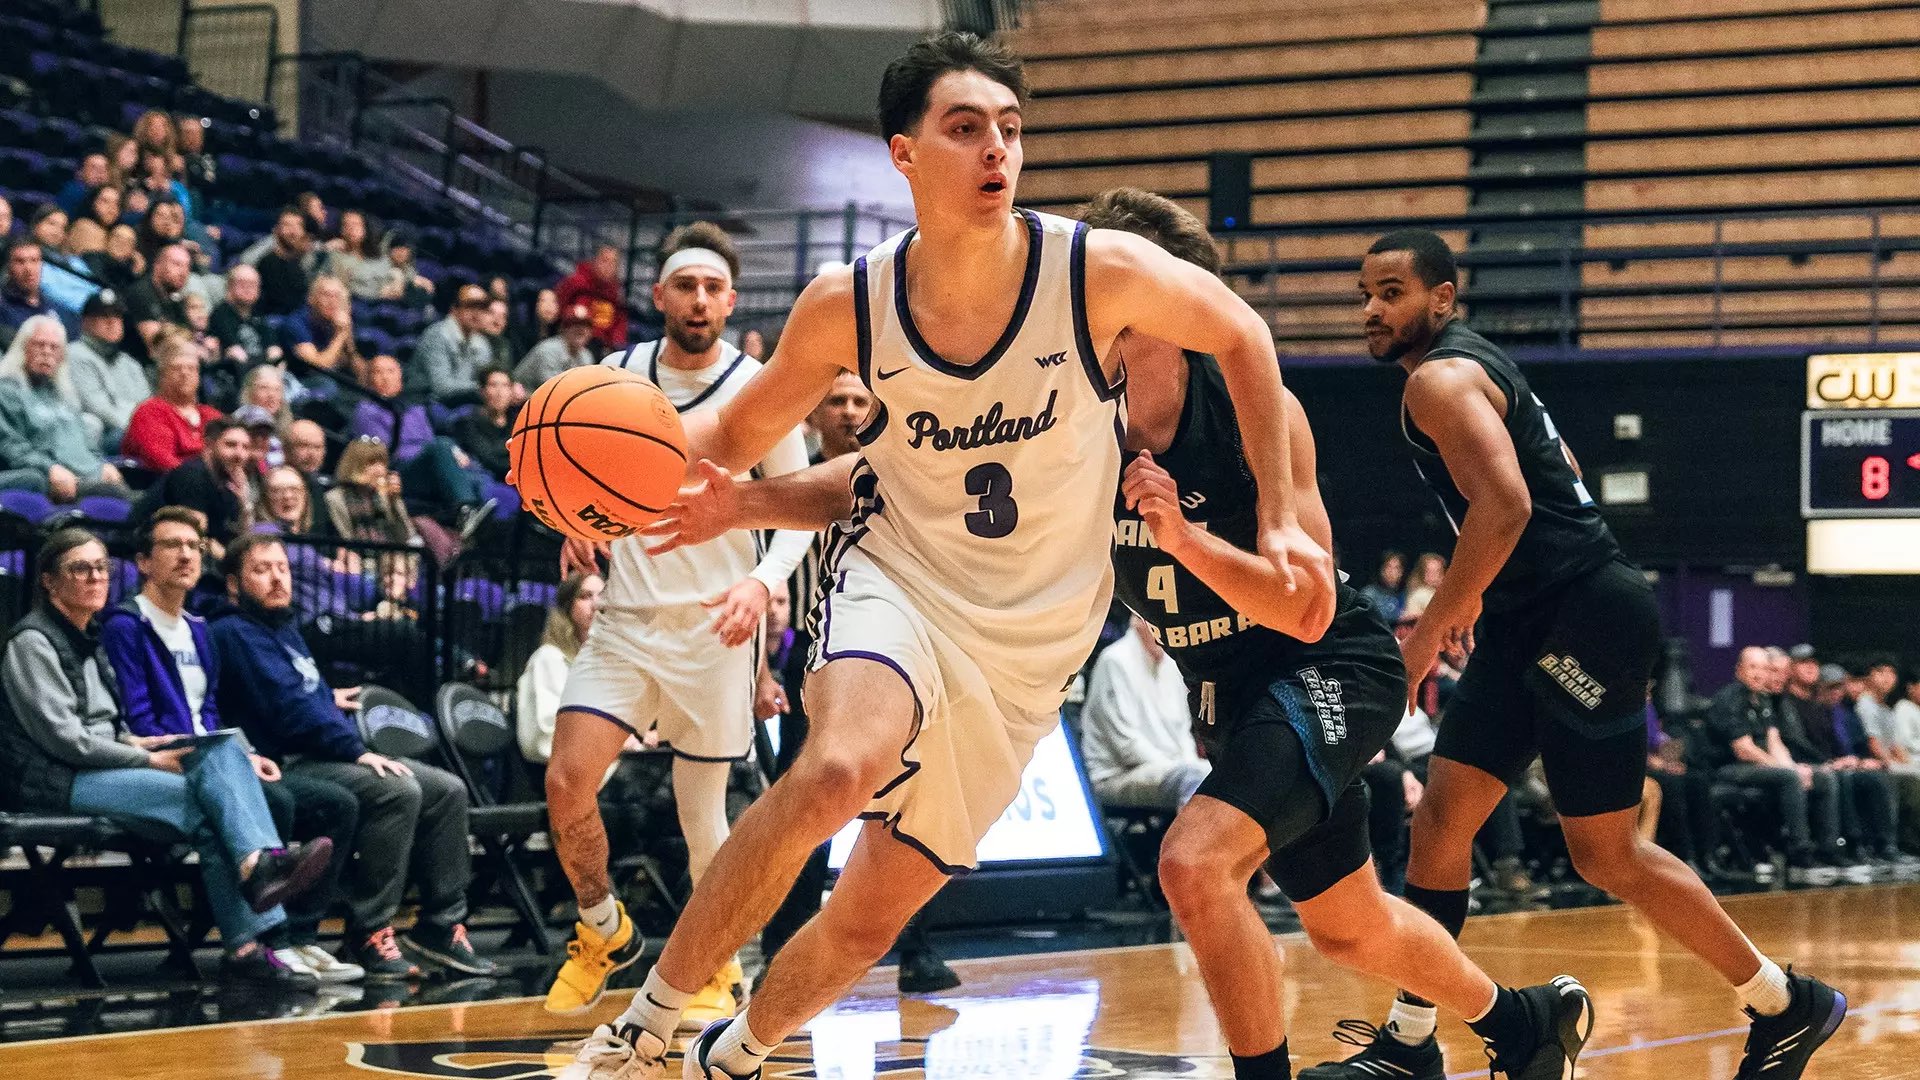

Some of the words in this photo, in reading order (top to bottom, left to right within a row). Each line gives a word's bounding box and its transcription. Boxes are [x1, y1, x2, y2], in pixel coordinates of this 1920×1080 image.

[1033, 350, 1068, 369] WCC
[906, 389, 1058, 451] Portland
[1821, 419, 1892, 446] HOME
[964, 462, 1019, 539] 3
[1861, 456, 1890, 500] 8
[1146, 564, 1179, 614] 4
